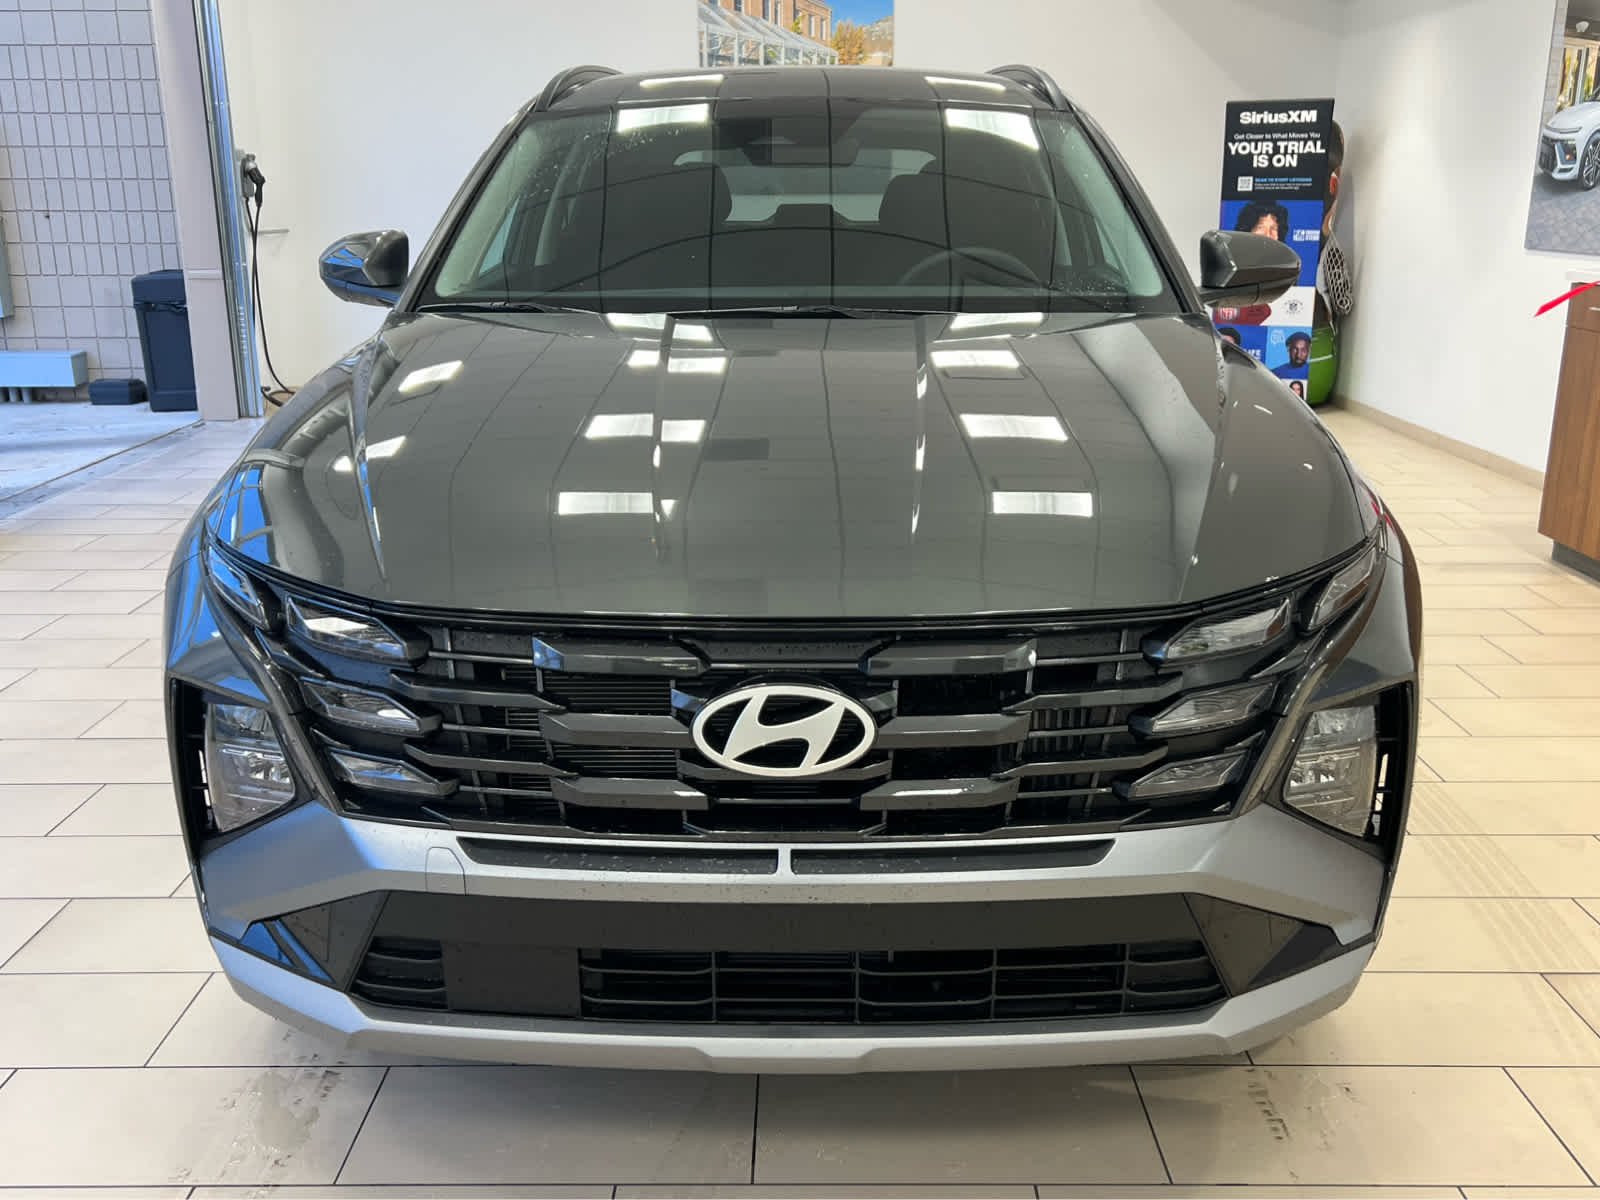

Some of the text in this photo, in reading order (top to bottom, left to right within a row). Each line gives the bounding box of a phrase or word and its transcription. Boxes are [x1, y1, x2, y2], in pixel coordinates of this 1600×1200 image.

[1239, 110, 1317, 124] SiriusXM
[1227, 140, 1326, 155] YOUR TRIAL
[1252, 153, 1298, 168] IS ON
